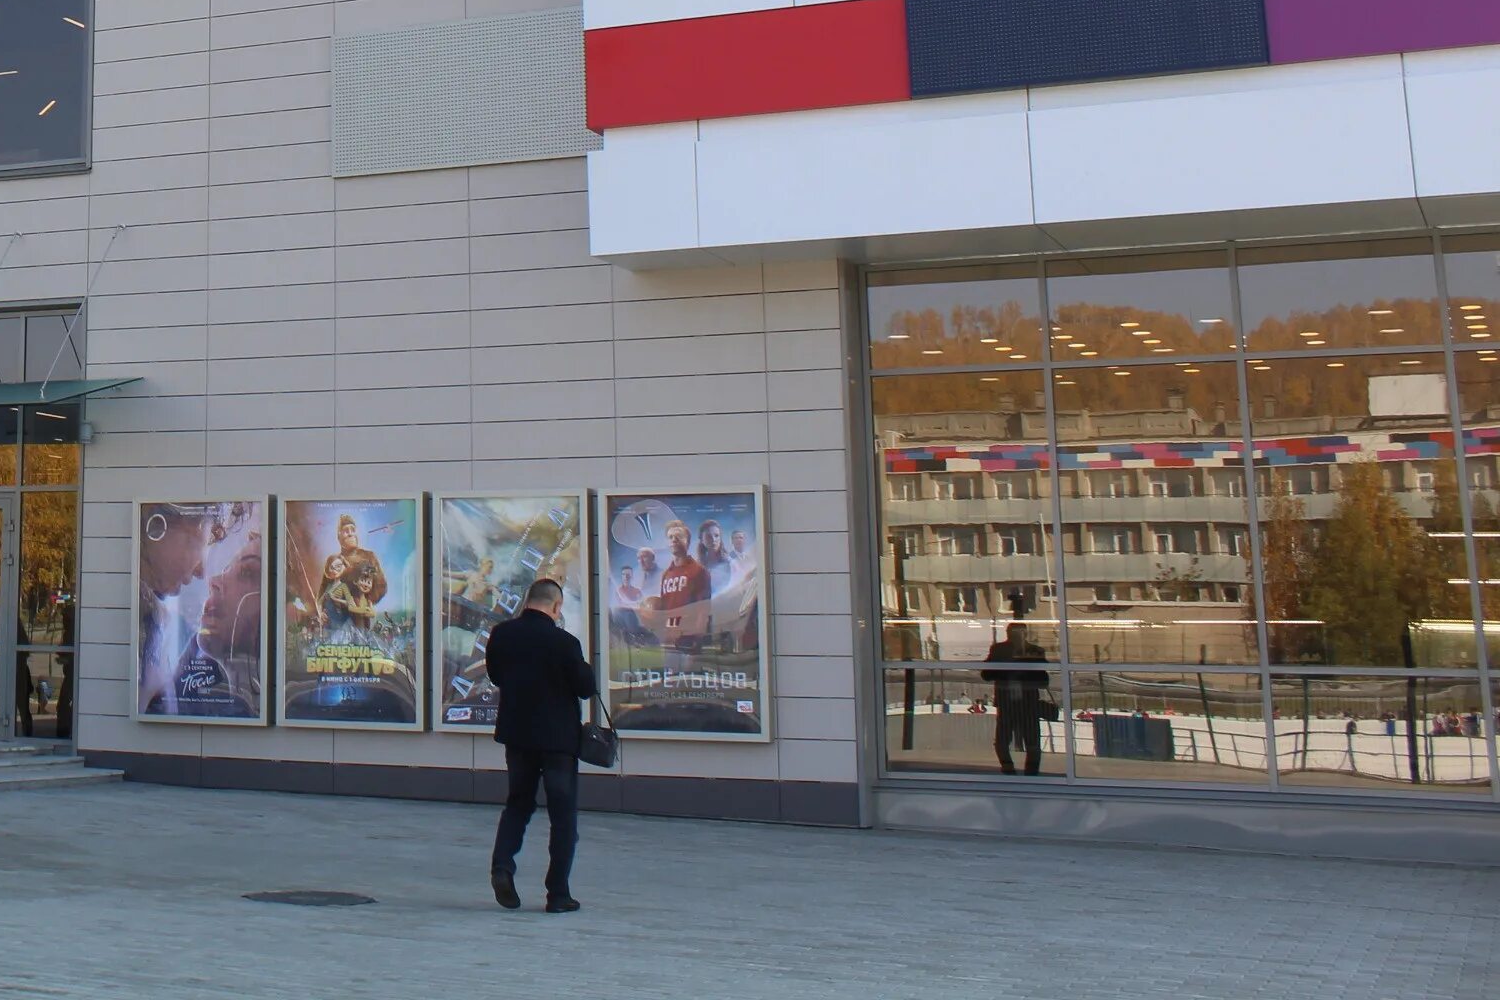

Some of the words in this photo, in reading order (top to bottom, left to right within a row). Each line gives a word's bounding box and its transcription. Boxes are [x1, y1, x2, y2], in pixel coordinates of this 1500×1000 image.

[663, 575, 688, 594] СССР
[316, 643, 373, 658] СЕМЕЙКА
[621, 670, 748, 691] СТРЕЛЬЦОВ
